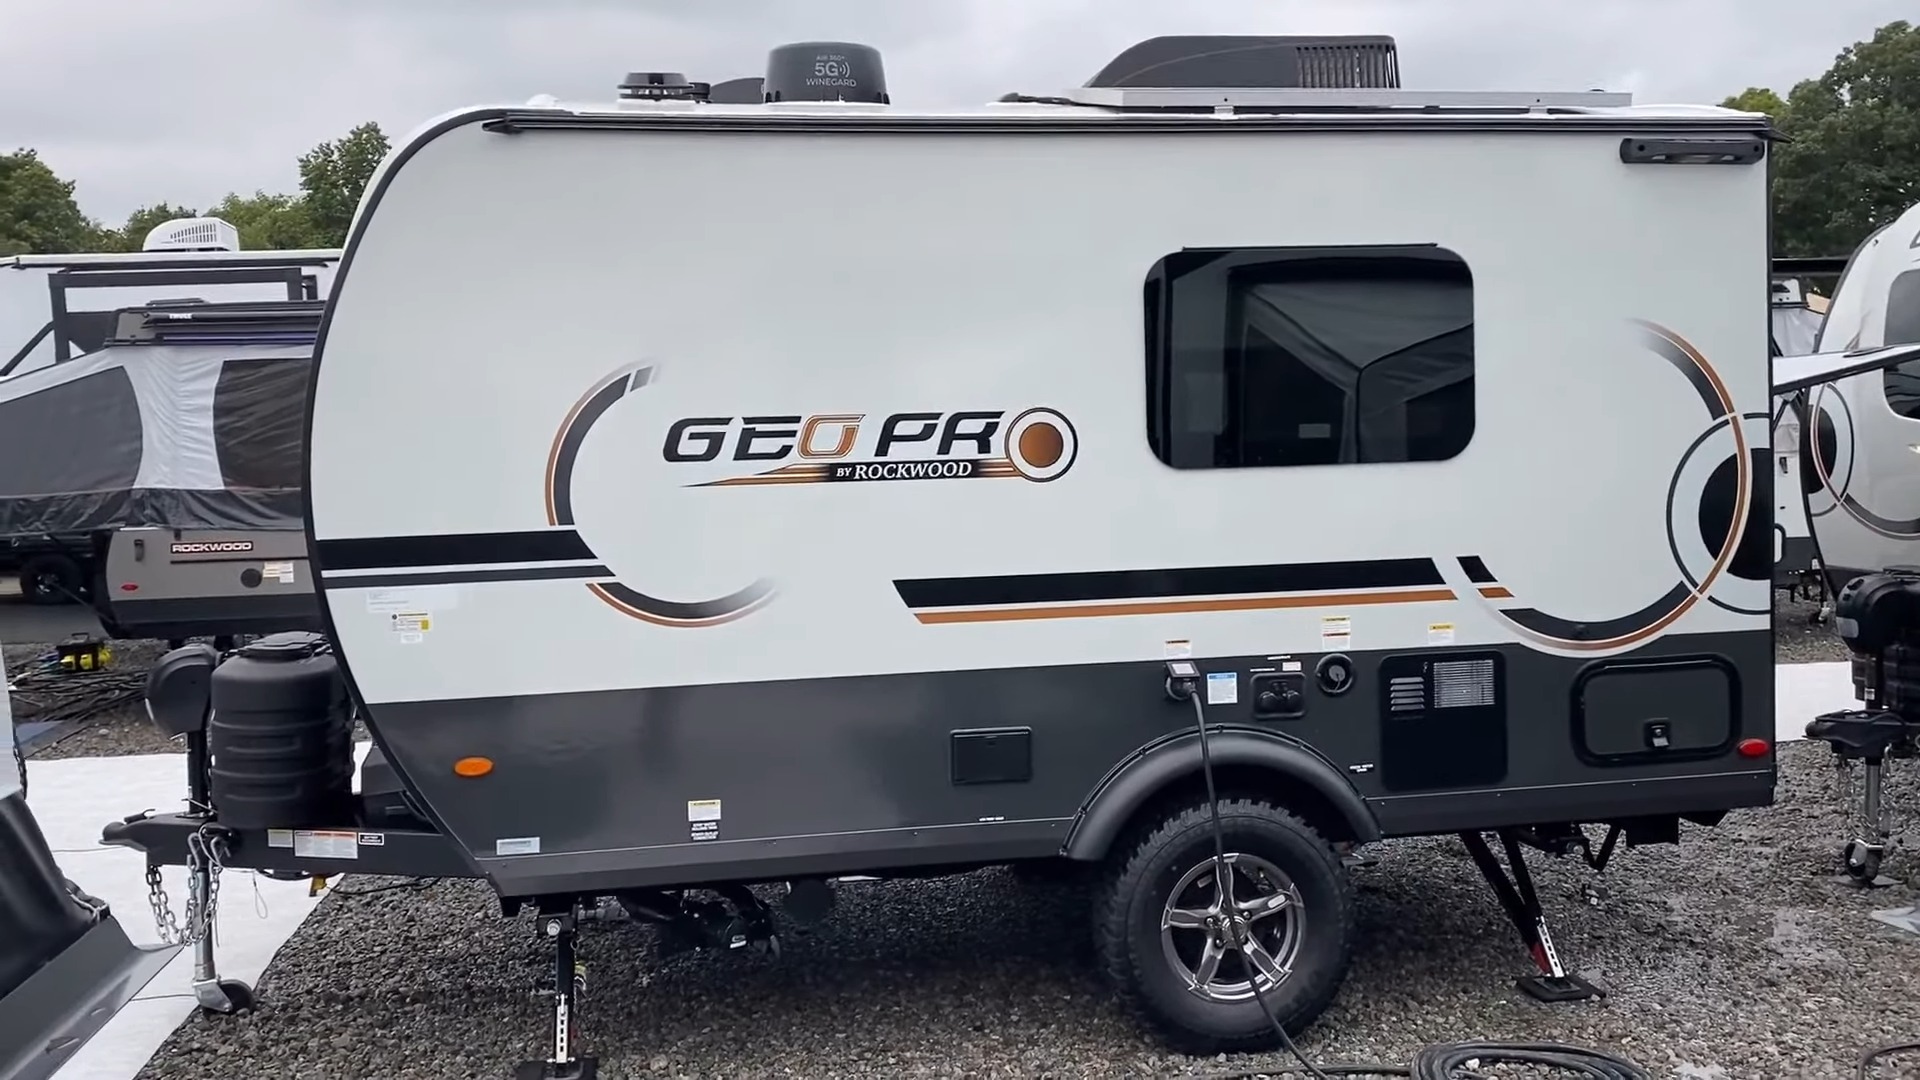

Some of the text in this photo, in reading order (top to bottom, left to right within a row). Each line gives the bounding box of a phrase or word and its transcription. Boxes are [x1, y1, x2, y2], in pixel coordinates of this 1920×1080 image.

[815, 61, 838, 76] 5G
[805, 77, 857, 87] WINEGARD
[663, 414, 866, 463] GEO
[836, 461, 972, 480] BY ROCKWOOD
[171, 542, 252, 553] ROCKWOOD
